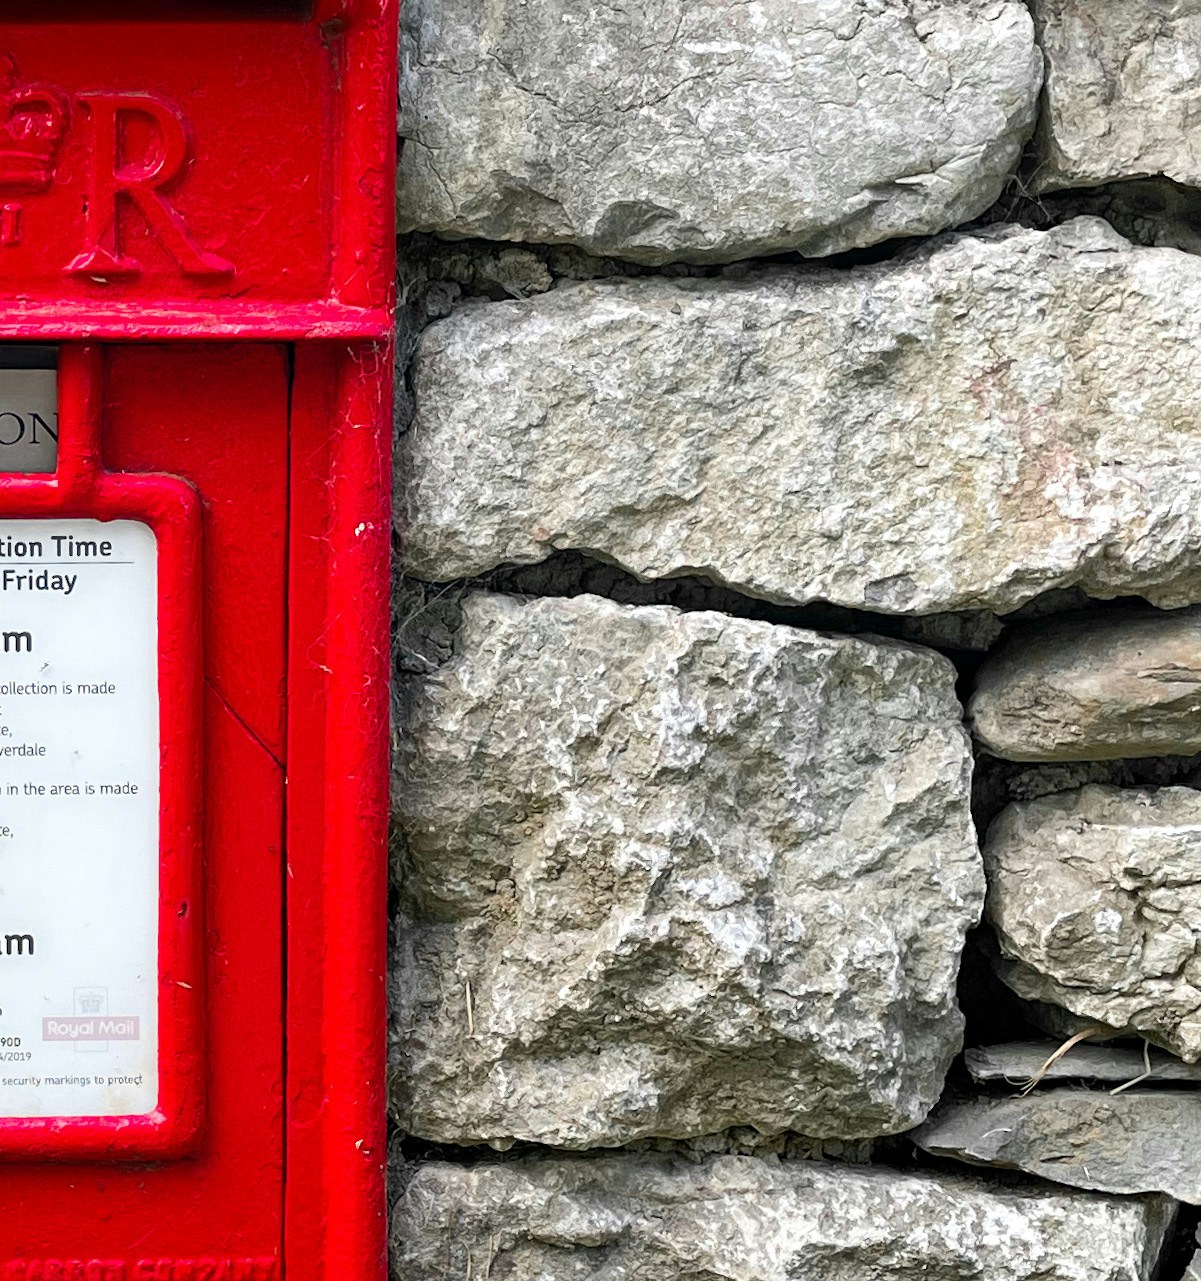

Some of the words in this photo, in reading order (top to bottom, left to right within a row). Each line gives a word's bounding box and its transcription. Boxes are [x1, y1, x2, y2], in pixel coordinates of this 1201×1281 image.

[51, 535, 112, 557] Time
[3, 569, 77, 595] Friday
[63, 682, 72, 694] is
[78, 682, 115, 694] made
[7, 783, 18, 795] in
[24, 783, 45, 795] the
[50, 785, 80, 795] area
[86, 782, 95, 794] is
[100, 781, 138, 794] made
[47, 1020, 95, 1038] Royal
[98, 1019, 135, 1035] Mail
[2, 1077, 41, 1087] security
[45, 1075, 91, 1087] markings
[94, 1076, 104, 1084] to
[108, 1074, 142, 1086] protect
